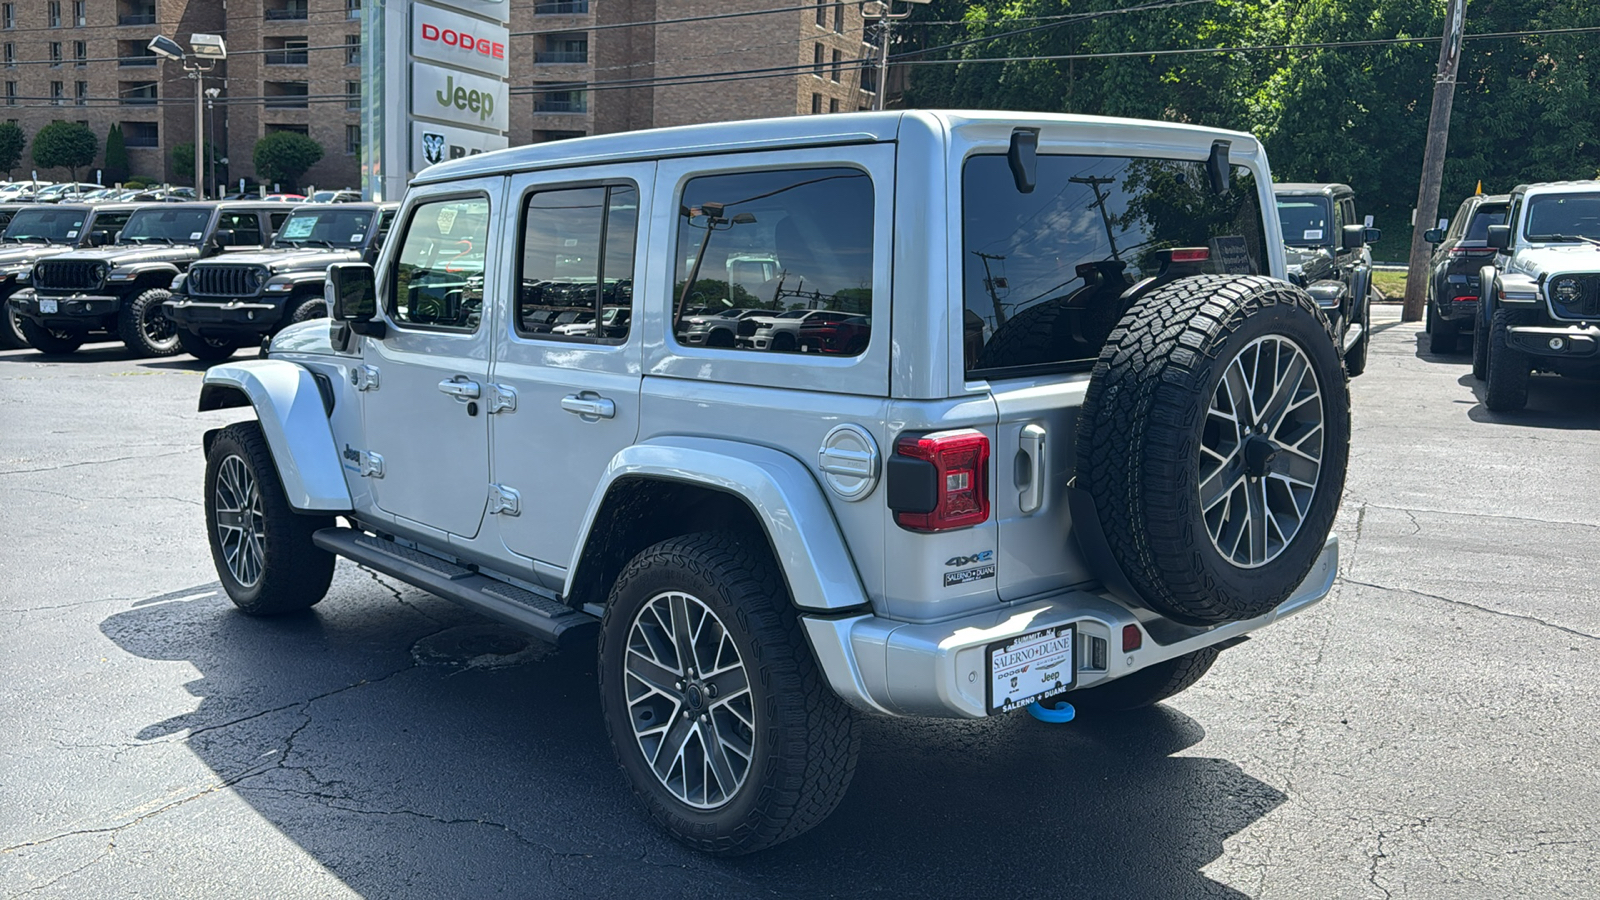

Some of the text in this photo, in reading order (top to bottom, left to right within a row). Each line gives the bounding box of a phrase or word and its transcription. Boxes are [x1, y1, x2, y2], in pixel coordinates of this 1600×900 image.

[422, 23, 504, 59] DODGE
[436, 76, 494, 121] Jeep
[994, 637, 1070, 671] SALERNO DUANE
[1041, 671, 1060, 683] Jeep
[1002, 685, 1067, 713] SALERNO DUANE
